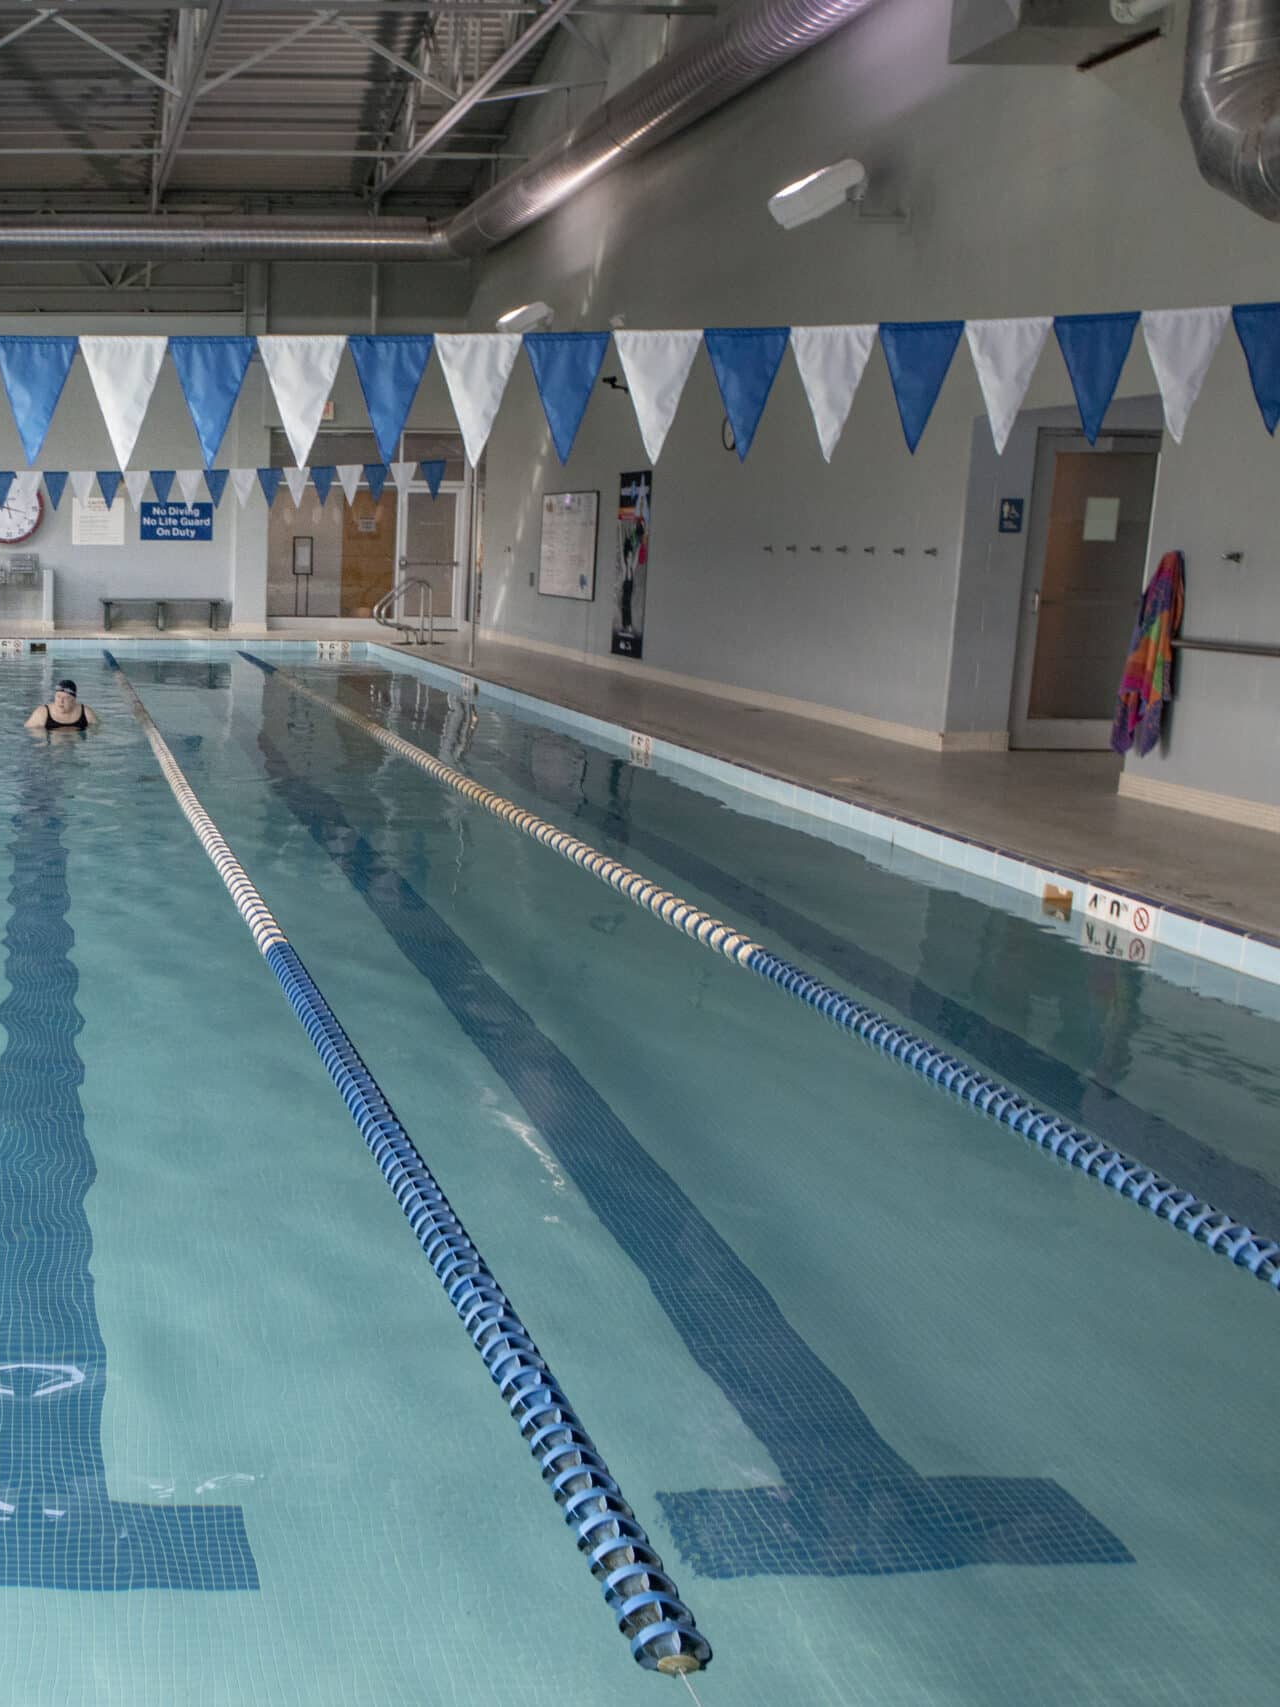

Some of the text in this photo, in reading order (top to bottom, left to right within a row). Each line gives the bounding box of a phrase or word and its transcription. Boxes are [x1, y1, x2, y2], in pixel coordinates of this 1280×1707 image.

[152, 507, 200, 516] No Diving
[142, 517, 211, 526] No Life Guard
[156, 527, 196, 539] On Duty
